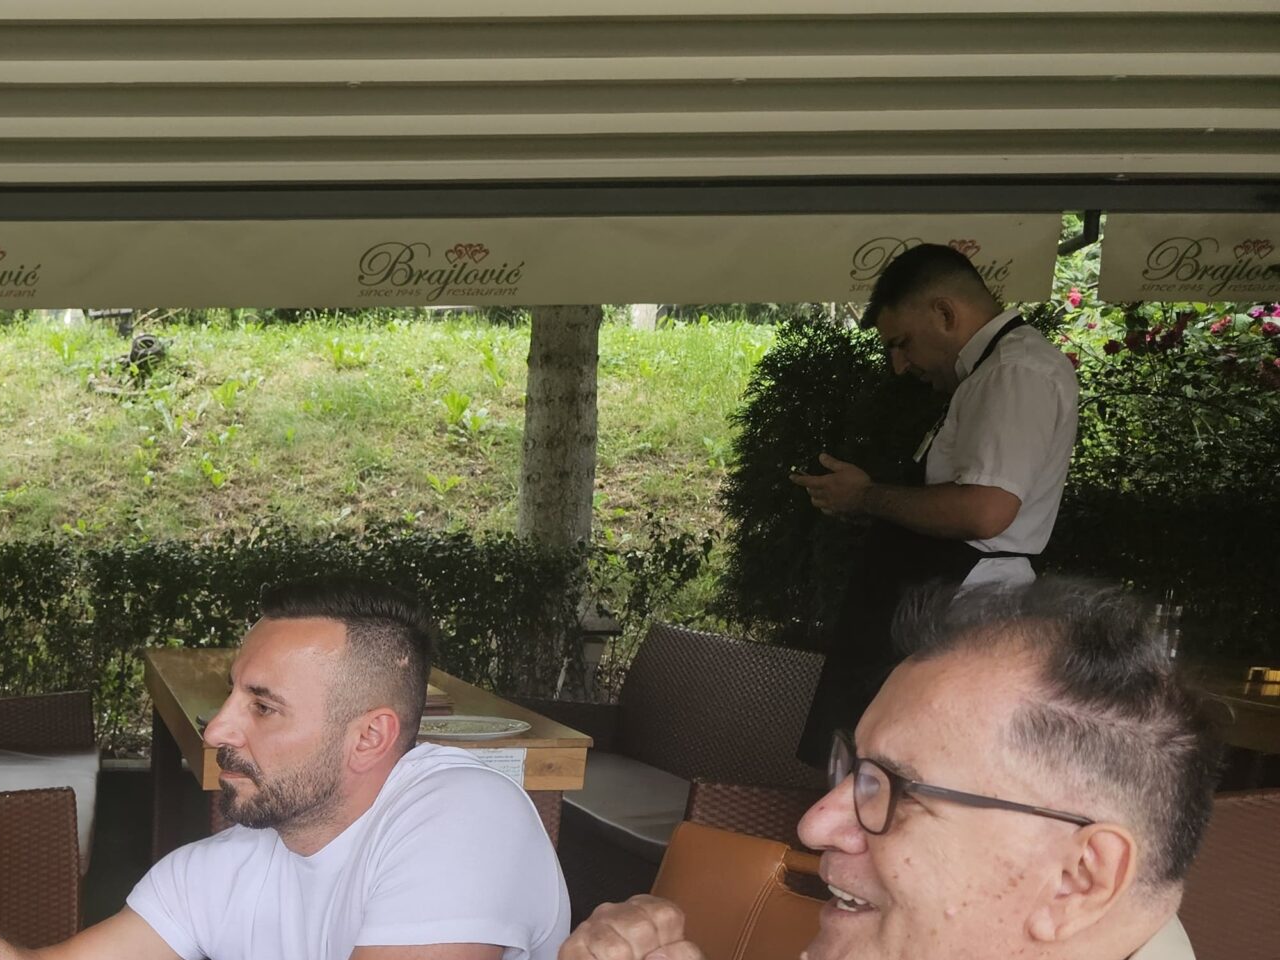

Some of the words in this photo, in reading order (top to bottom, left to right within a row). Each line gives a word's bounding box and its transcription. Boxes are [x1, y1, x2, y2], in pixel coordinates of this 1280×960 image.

[358, 241, 525, 302] Brajlović
[358, 287, 393, 297] since
[396, 288, 421, 297] 1945
[447, 286, 519, 297] restaurant
